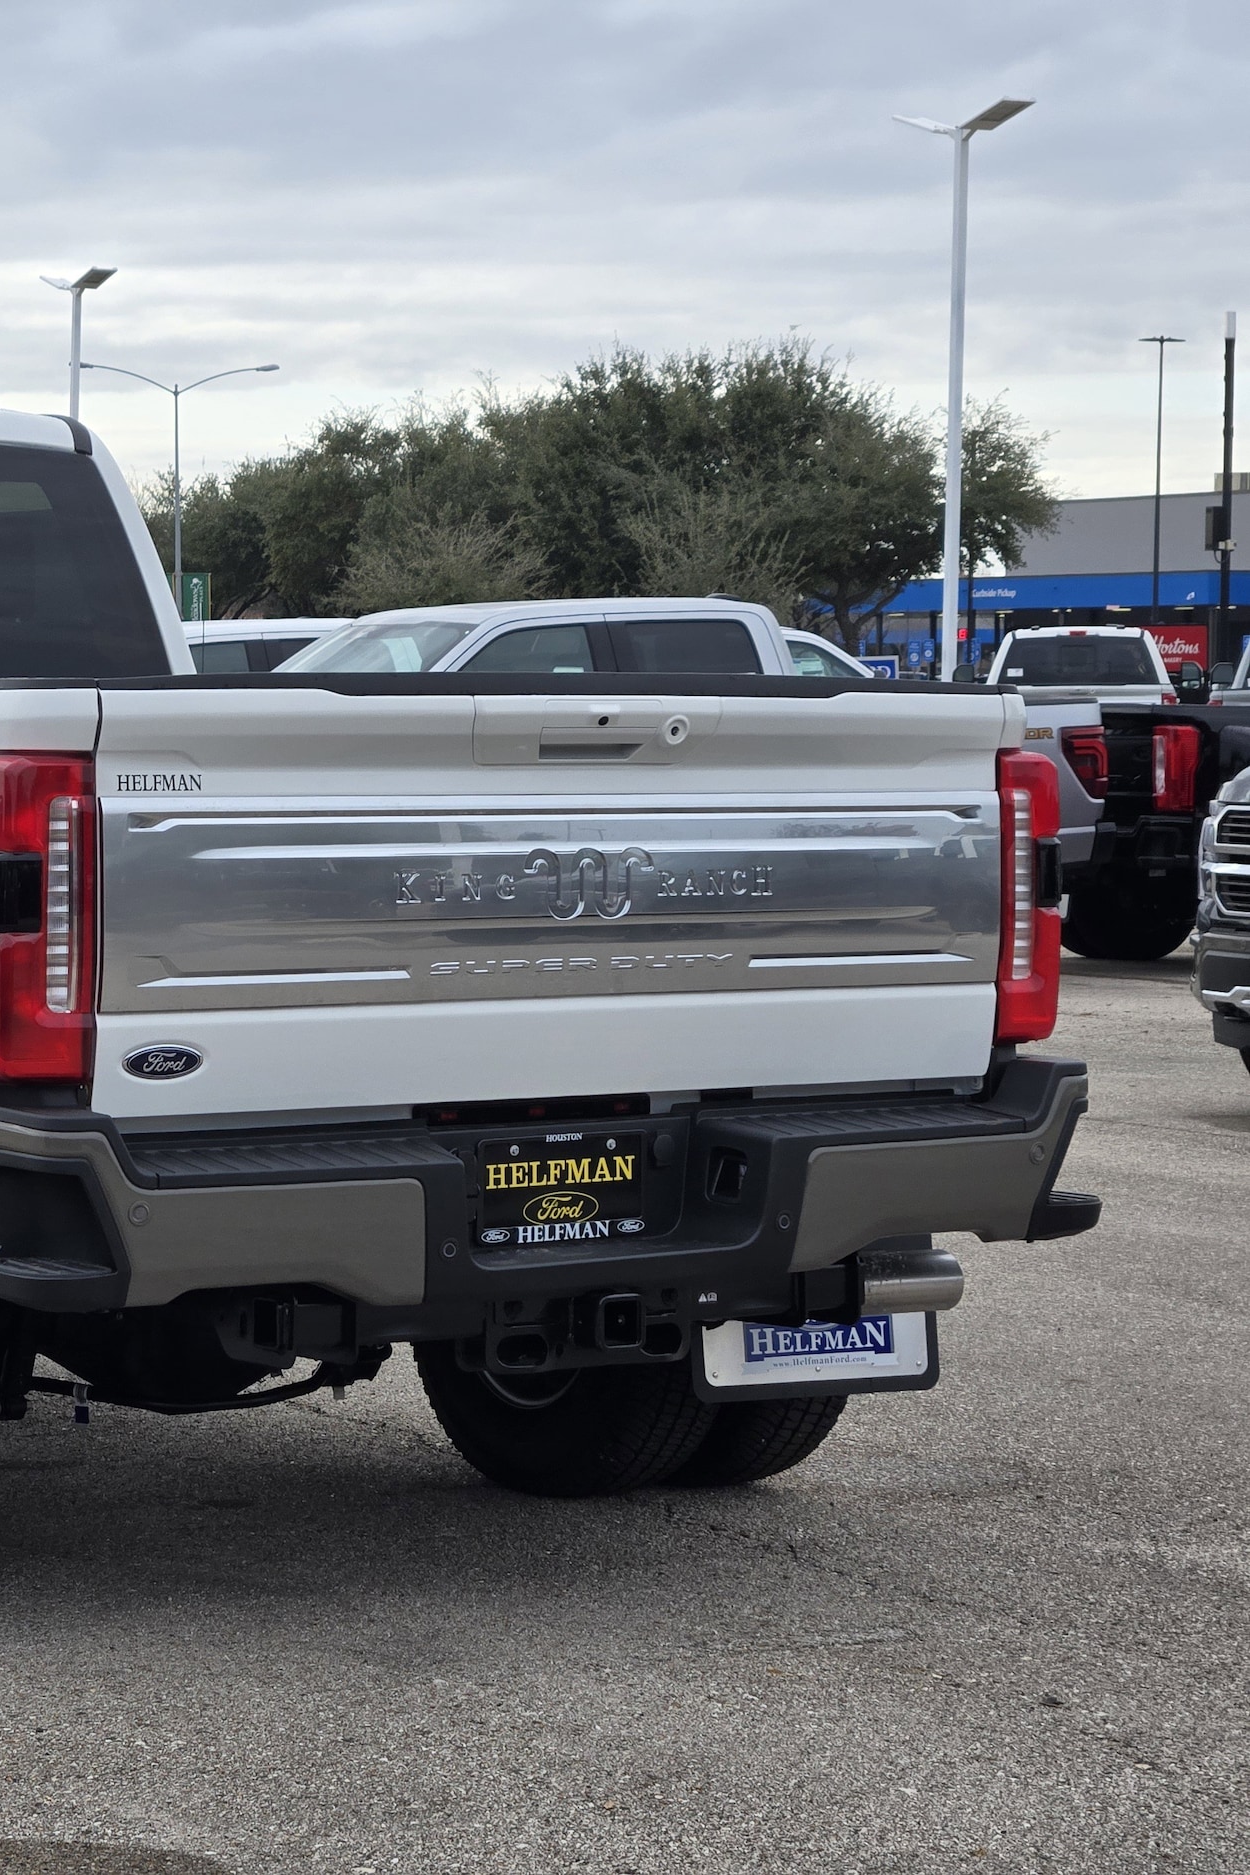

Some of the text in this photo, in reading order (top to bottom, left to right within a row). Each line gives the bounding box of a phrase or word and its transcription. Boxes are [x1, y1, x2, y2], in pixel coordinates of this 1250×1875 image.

[997, 588, 1017, 598] Pickup
[116, 774, 202, 792] HELFMAN
[393, 864, 774, 904] KING RANCH
[429, 953, 734, 976] SUPER DUTY
[142, 1051, 188, 1073] Ford
[545, 1132, 584, 1143] HOUSTON
[485, 1155, 636, 1190] HELFMAN
[537, 1195, 585, 1221] Ford
[517, 1219, 612, 1244] HELFMAN
[750, 1320, 887, 1355] HELFMAN
[772, 1354, 867, 1368] www.HelfmanFord.com
